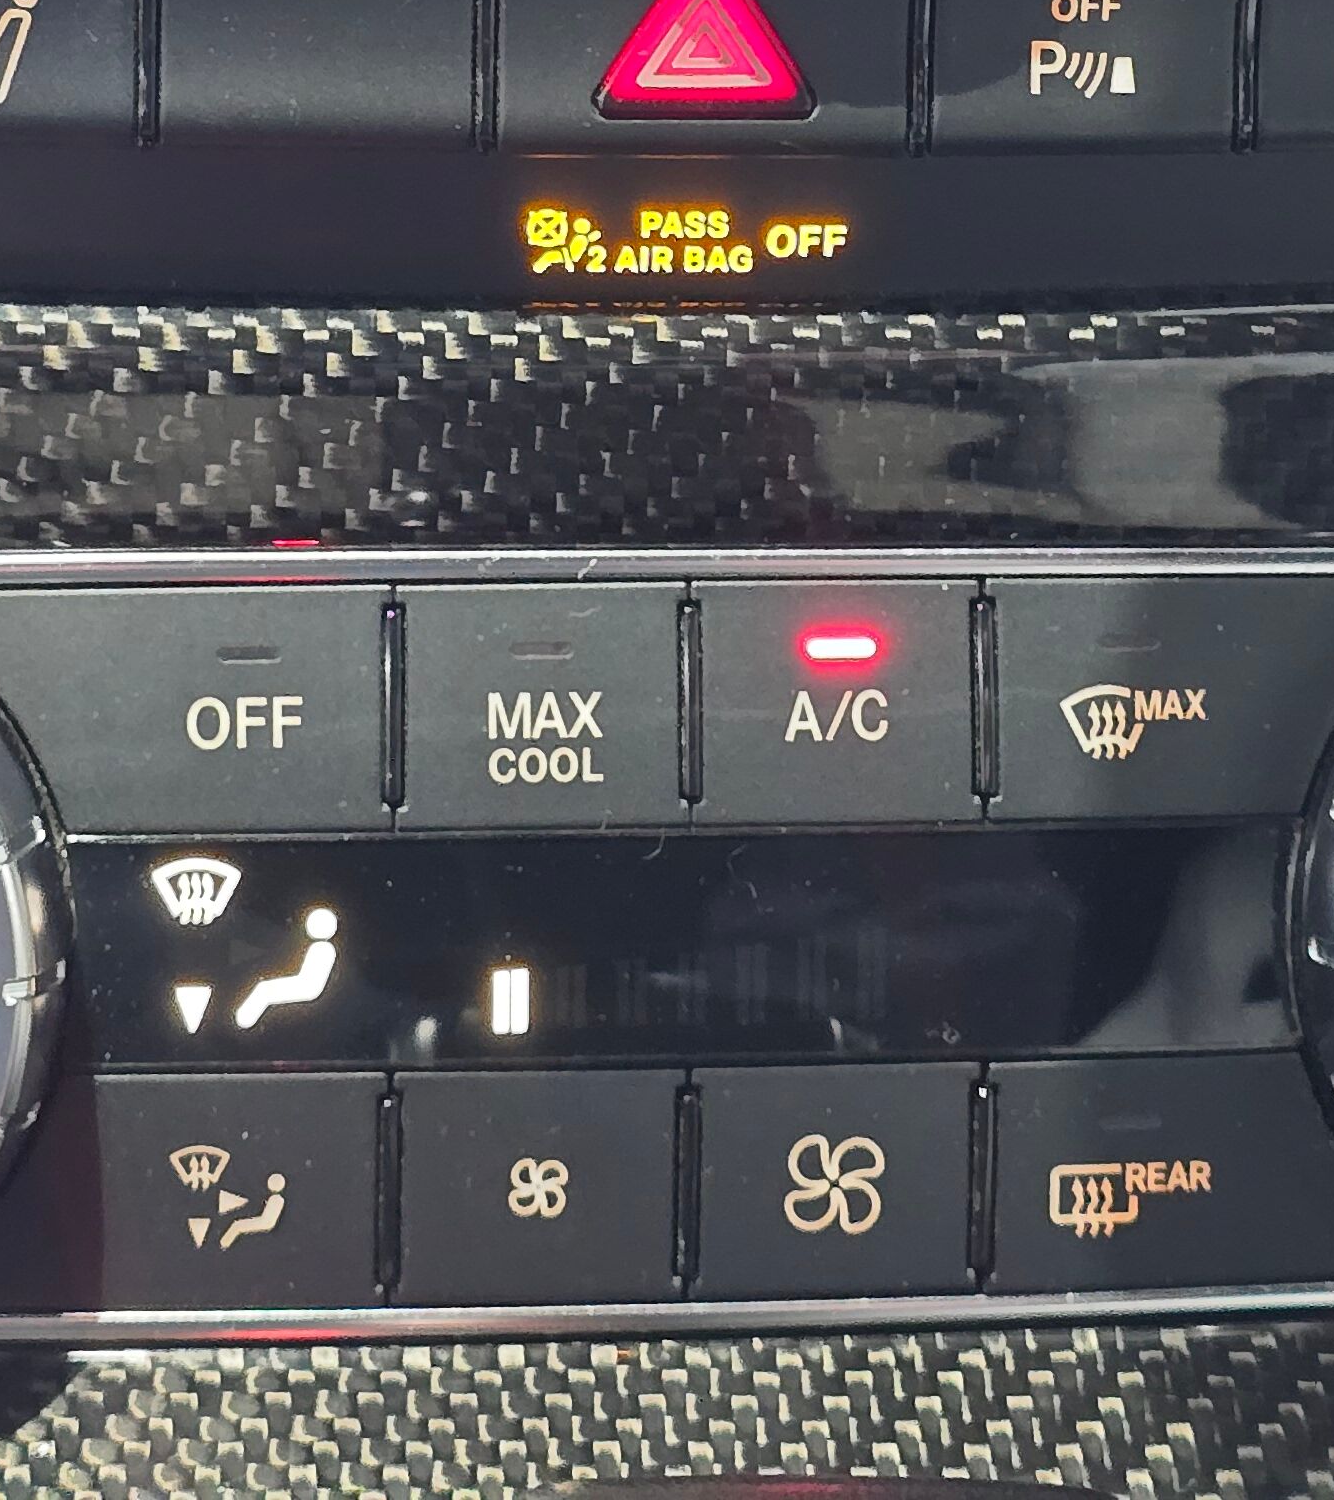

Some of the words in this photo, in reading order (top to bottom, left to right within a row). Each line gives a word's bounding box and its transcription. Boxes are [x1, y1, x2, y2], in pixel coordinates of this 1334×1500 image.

[640, 210, 730, 239] PASS
[765, 223, 848, 259] OFF
[613, 243, 674, 274] AIR
[682, 244, 754, 274] BAG
[186, 695, 304, 750] OFF
[487, 691, 604, 740] MAX
[784, 688, 889, 742] A/C
[1133, 688, 1208, 722] MAX
[488, 746, 604, 784] COOL
[1124, 1160, 1211, 1194] REAR
